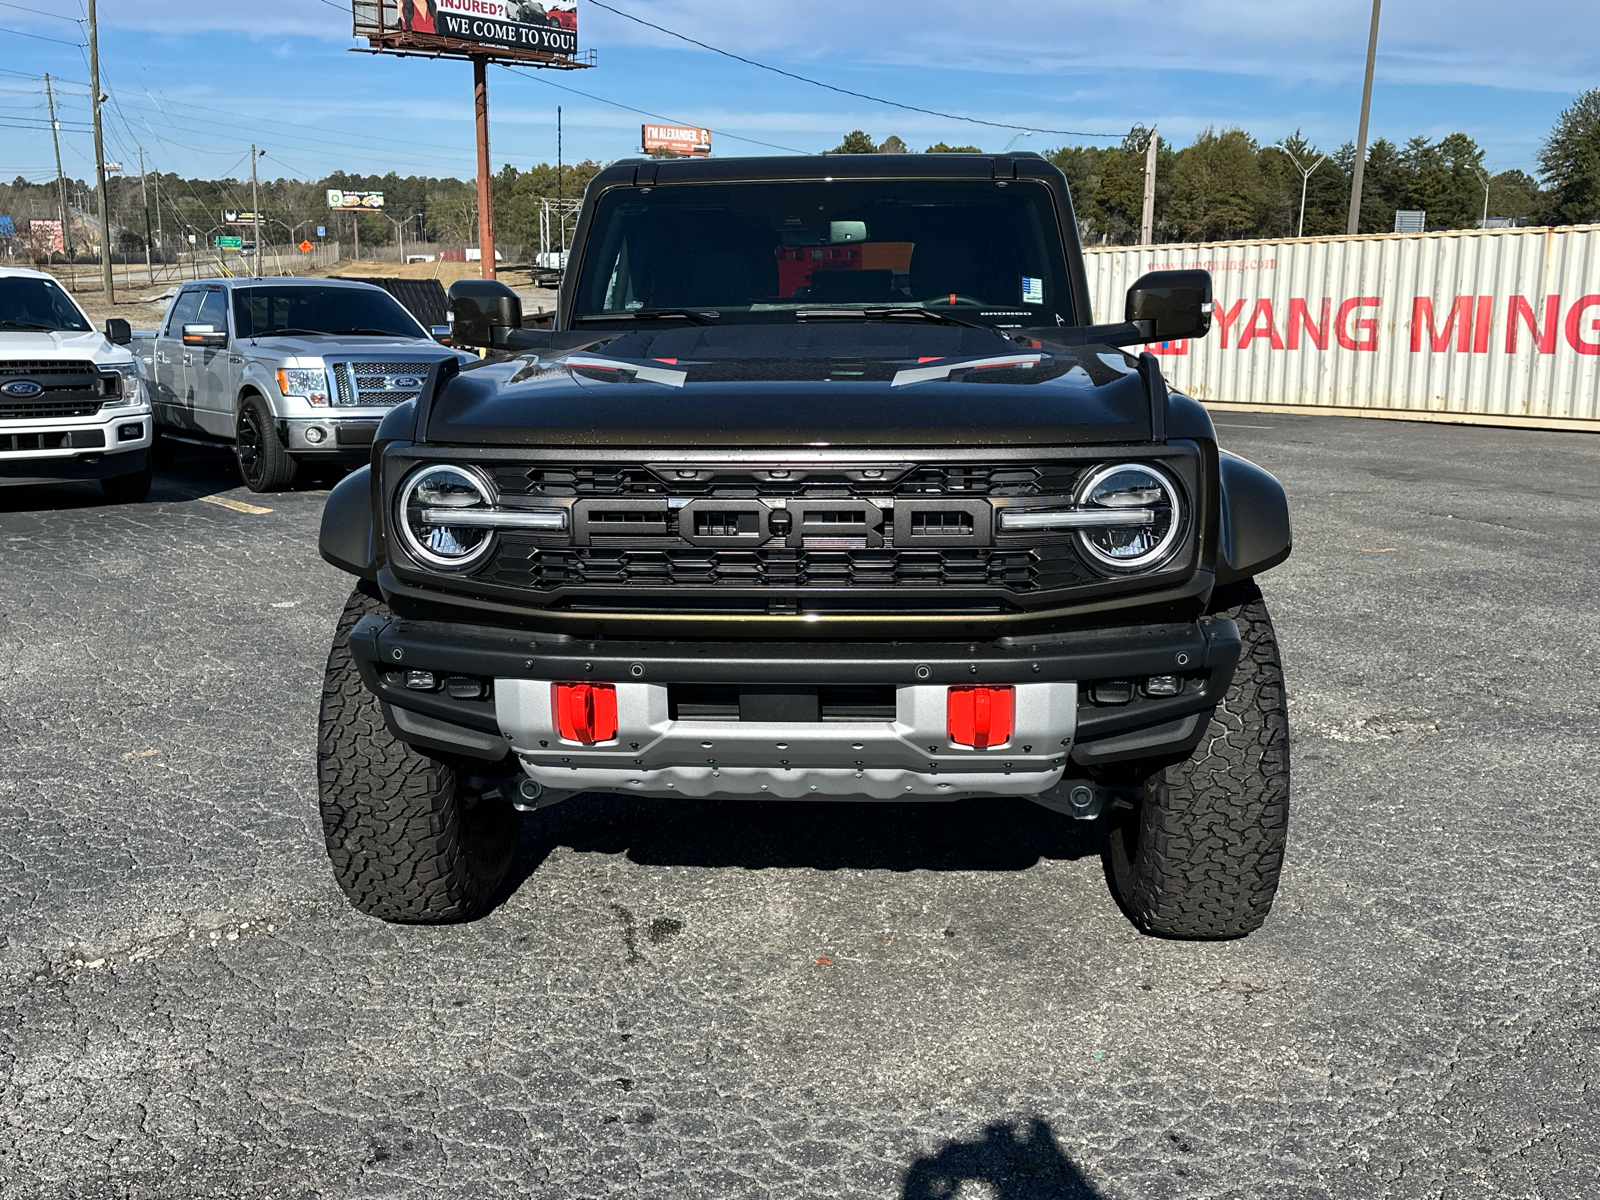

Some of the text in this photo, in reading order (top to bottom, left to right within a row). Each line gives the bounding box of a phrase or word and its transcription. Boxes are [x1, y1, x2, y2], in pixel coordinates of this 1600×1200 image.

[440, 0, 504, 16] INJURED?
[445, 16, 470, 34] WE
[473, 21, 516, 41] COME
[519, 27, 539, 45] TO
[542, 31, 575, 50] YOU!
[647, 126, 699, 142] I'M ALEXANDER.
[1212, 294, 1600, 356] YANG MING
[571, 497, 994, 548] FORD
